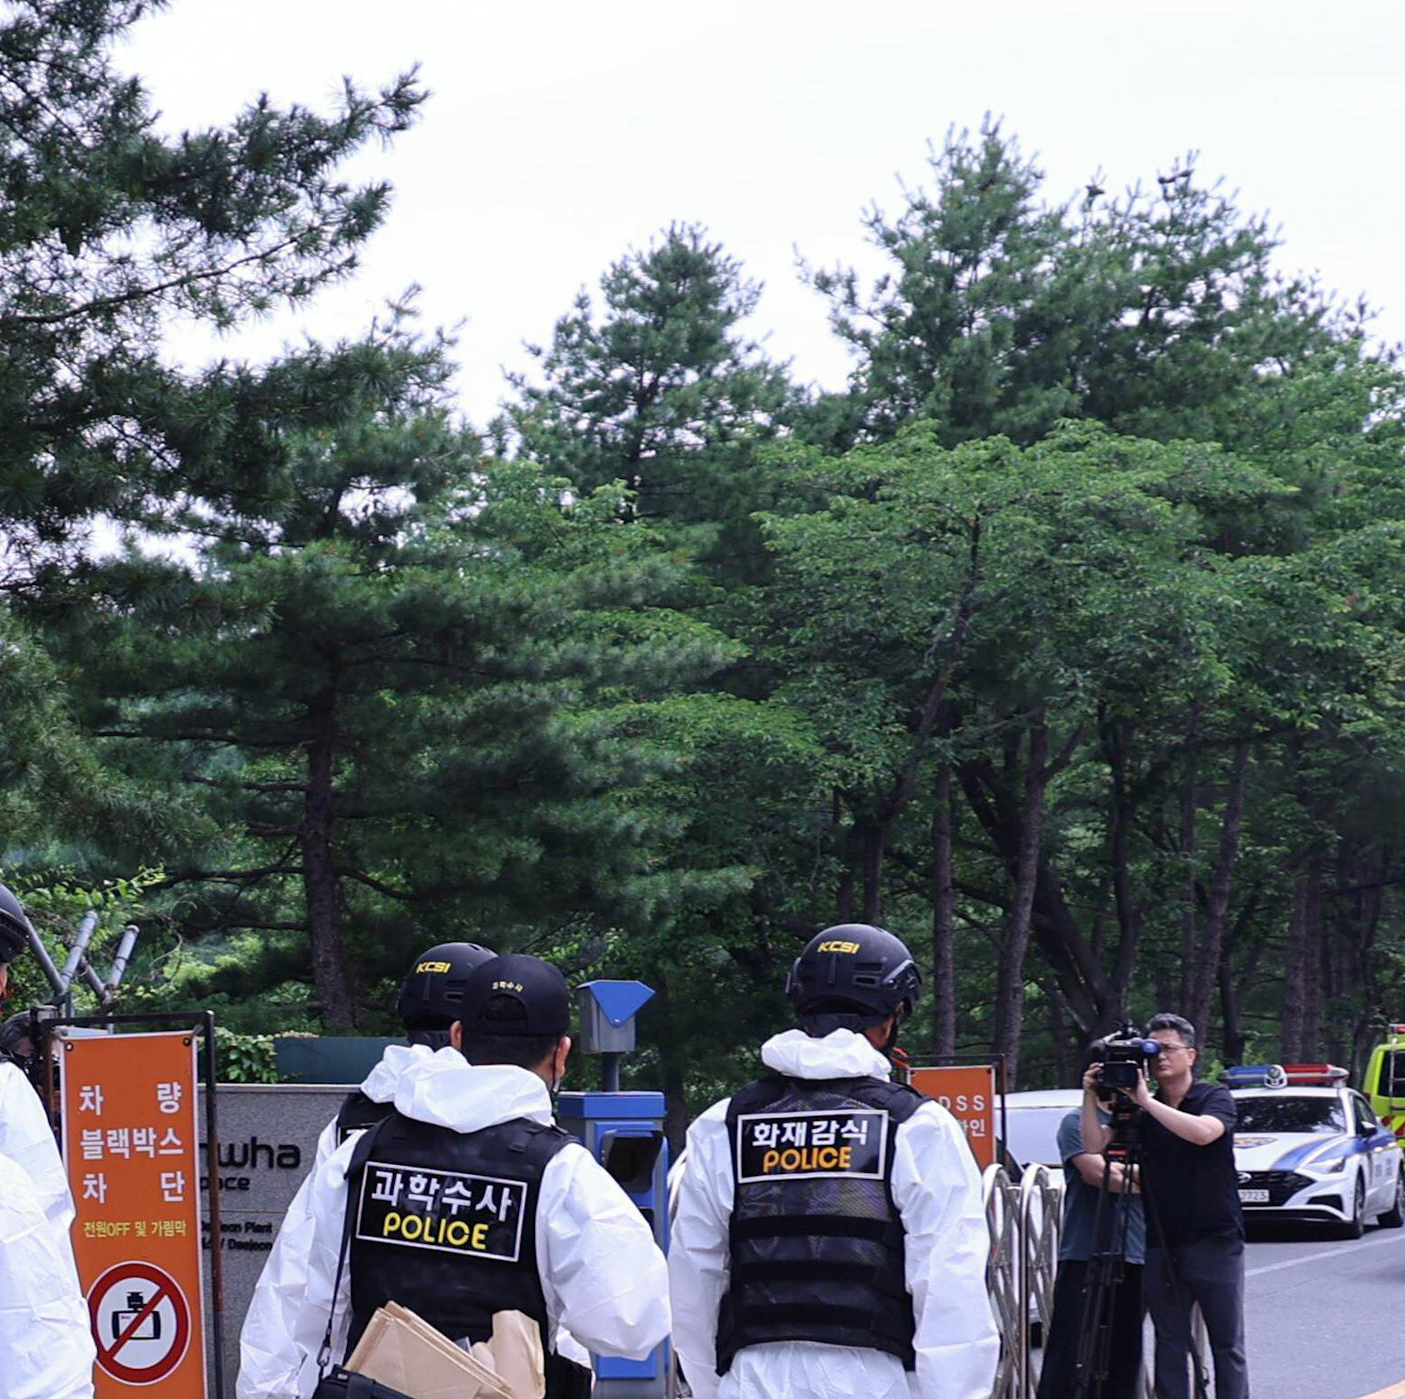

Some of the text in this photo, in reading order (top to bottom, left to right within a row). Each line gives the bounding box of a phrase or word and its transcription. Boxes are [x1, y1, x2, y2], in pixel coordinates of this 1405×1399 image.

[817, 941, 860, 954] KCSI
[416, 961, 452, 974] KCSI
[79, 1082, 182, 1116] 차 량
[80, 1127, 184, 1160] 블랙박스
[752, 1119, 869, 1148] 화재감식
[763, 1147, 853, 1173] POLICE
[83, 1170, 186, 1204] 차 단
[370, 1170, 513, 1223] 과학수사
[83, 1220, 187, 1238] 전원OFF 및 가림막
[383, 1211, 489, 1250] POLICE
